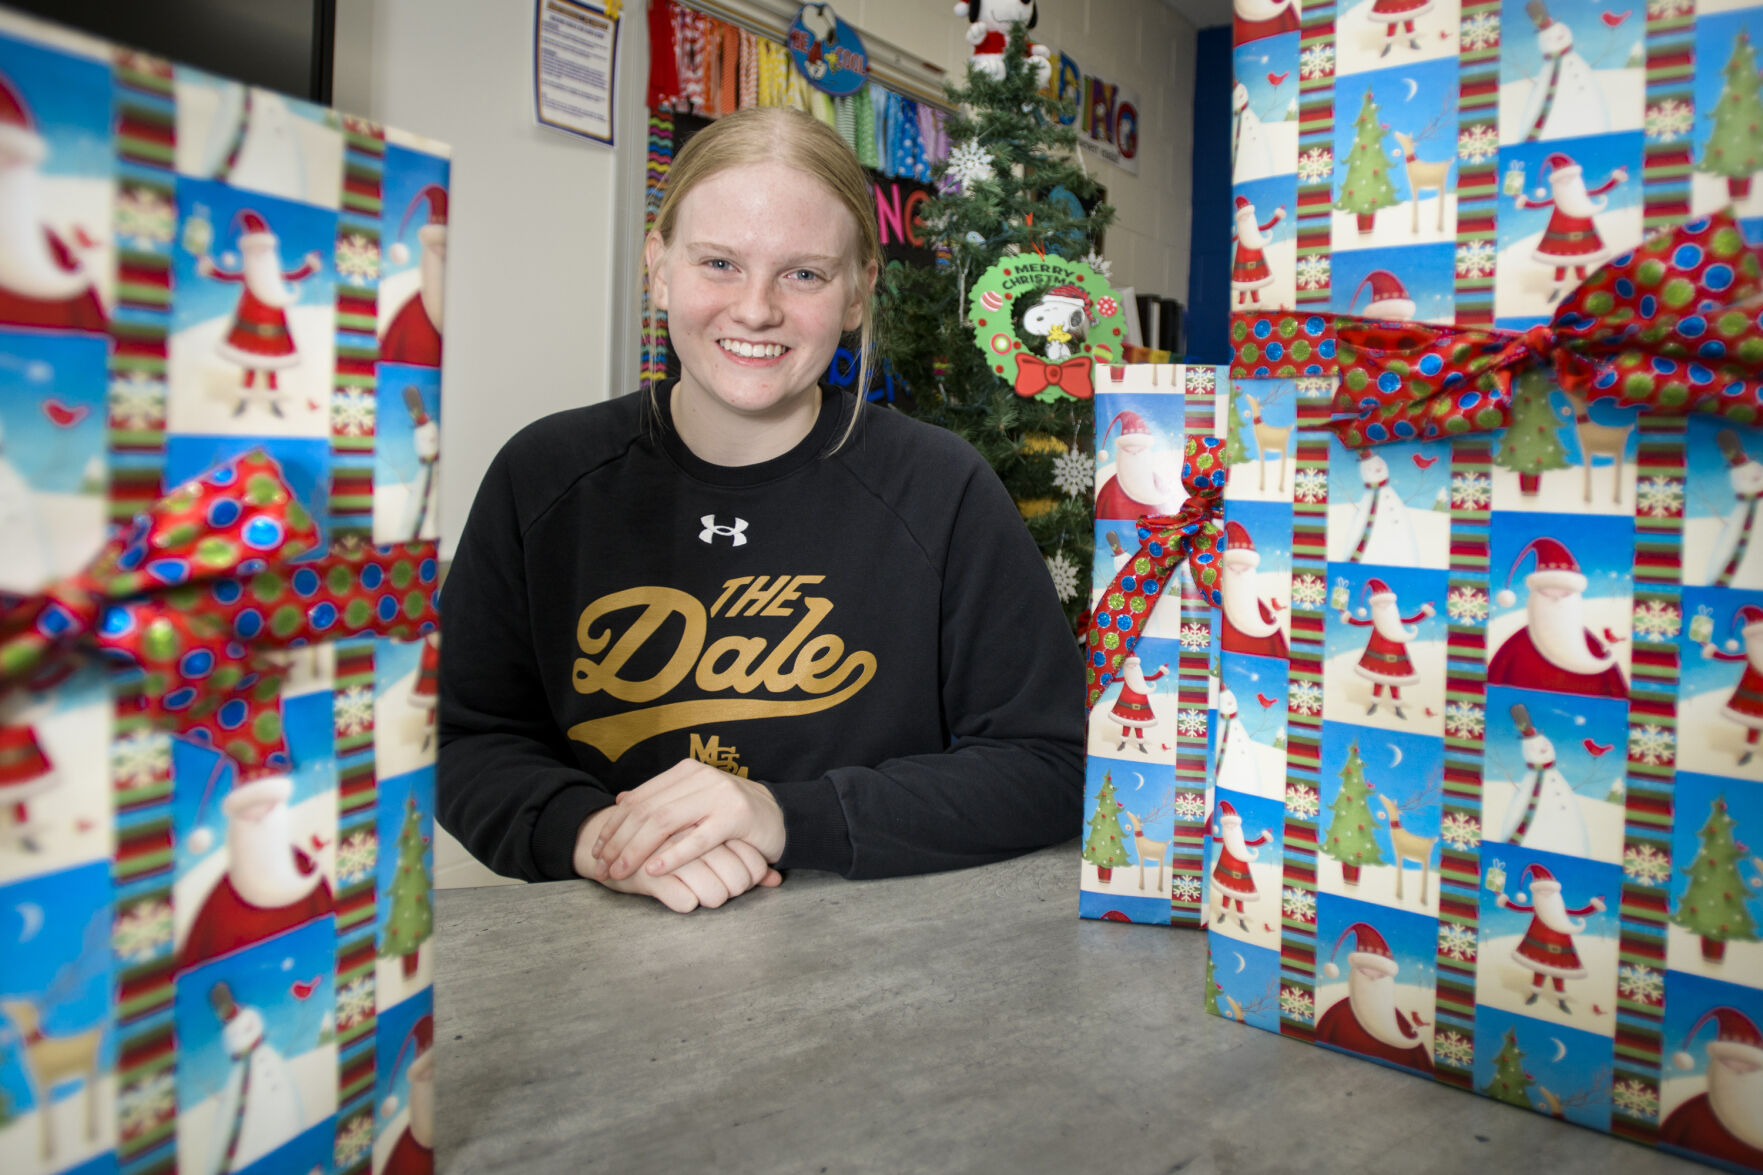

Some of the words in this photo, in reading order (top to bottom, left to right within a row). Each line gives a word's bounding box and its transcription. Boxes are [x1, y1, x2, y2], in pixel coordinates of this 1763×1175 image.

[1014, 262, 1075, 278] MERRY
[710, 574, 826, 618] THE
[572, 586, 878, 703] Dale
